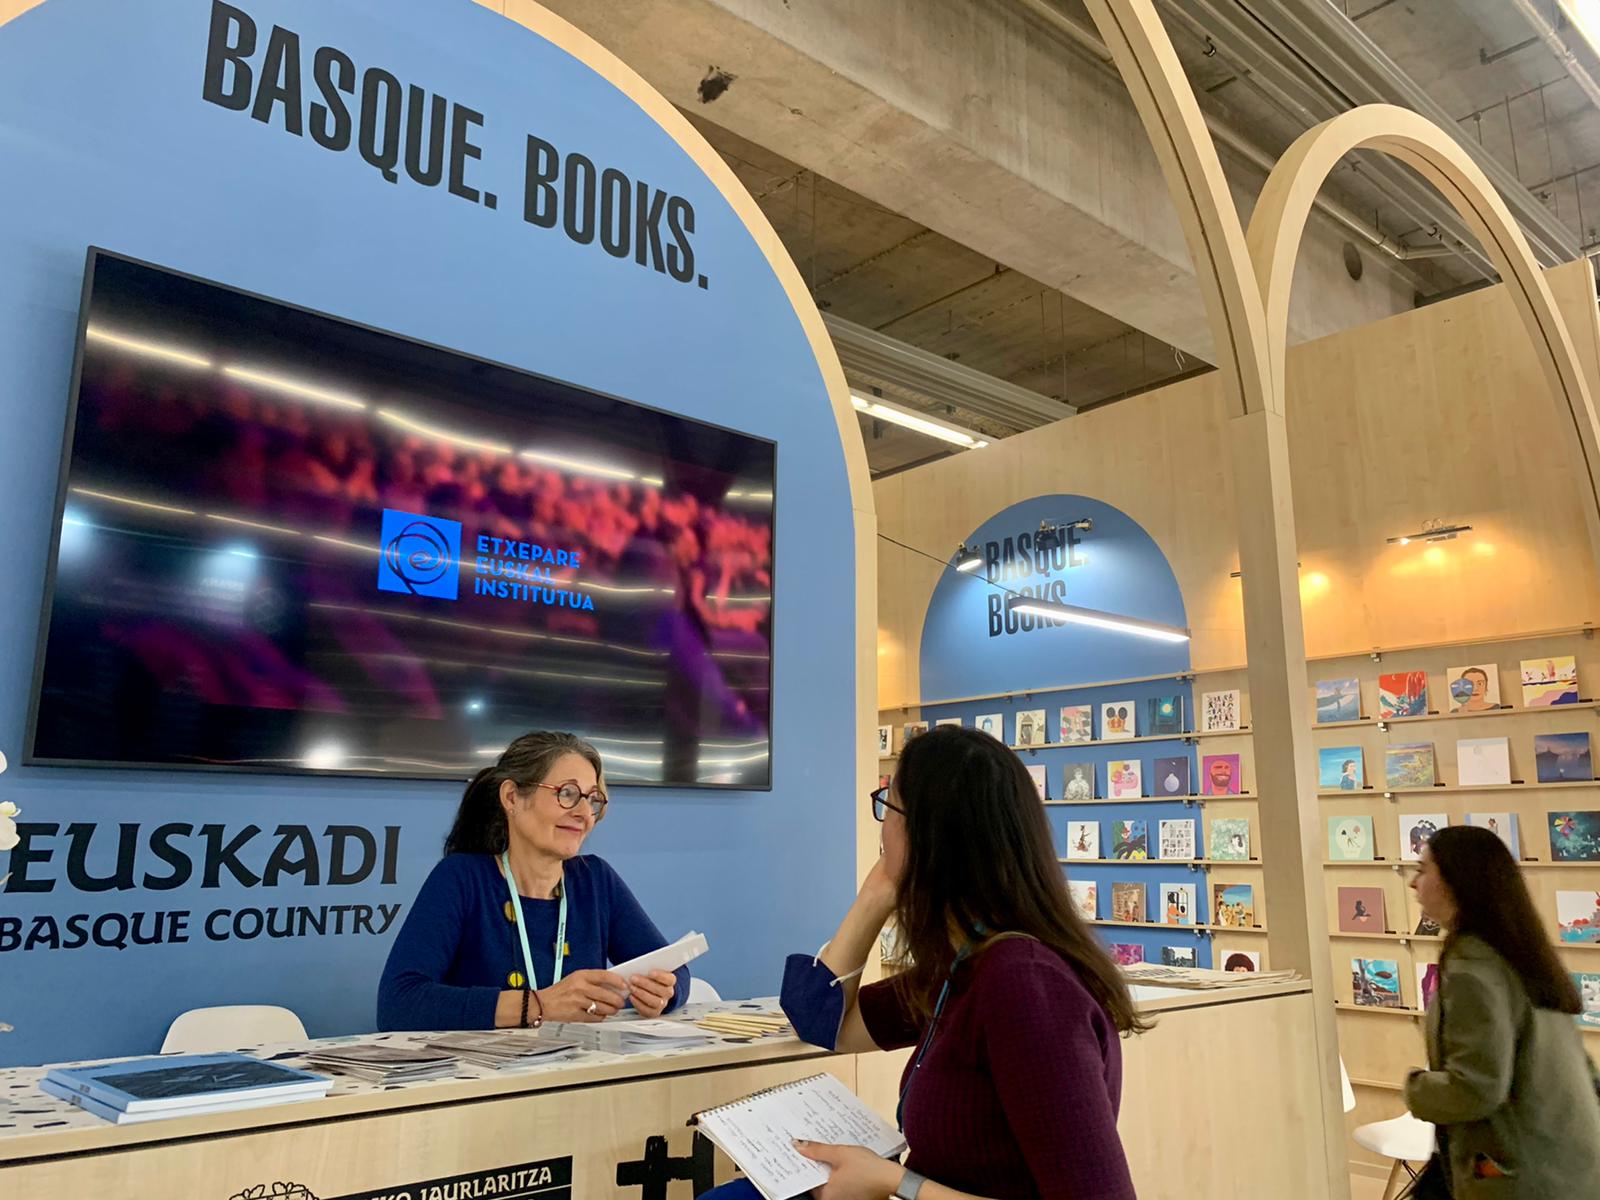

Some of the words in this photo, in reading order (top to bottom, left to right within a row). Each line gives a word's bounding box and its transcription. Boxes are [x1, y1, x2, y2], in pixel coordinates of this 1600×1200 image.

[202, 0, 497, 210] BASQUE.
[523, 134, 709, 290] BOOKS.
[477, 534, 581, 569] ETXEPARE
[475, 555, 556, 585] EUSKAL
[474, 577, 594, 611] INSTITUTUA
[3, 822, 402, 893] EUSKADI
[0, 910, 191, 951] BASQUE
[204, 903, 402, 942] COUNTRY
[420, 1166, 552, 1200] JAURLARITZA
